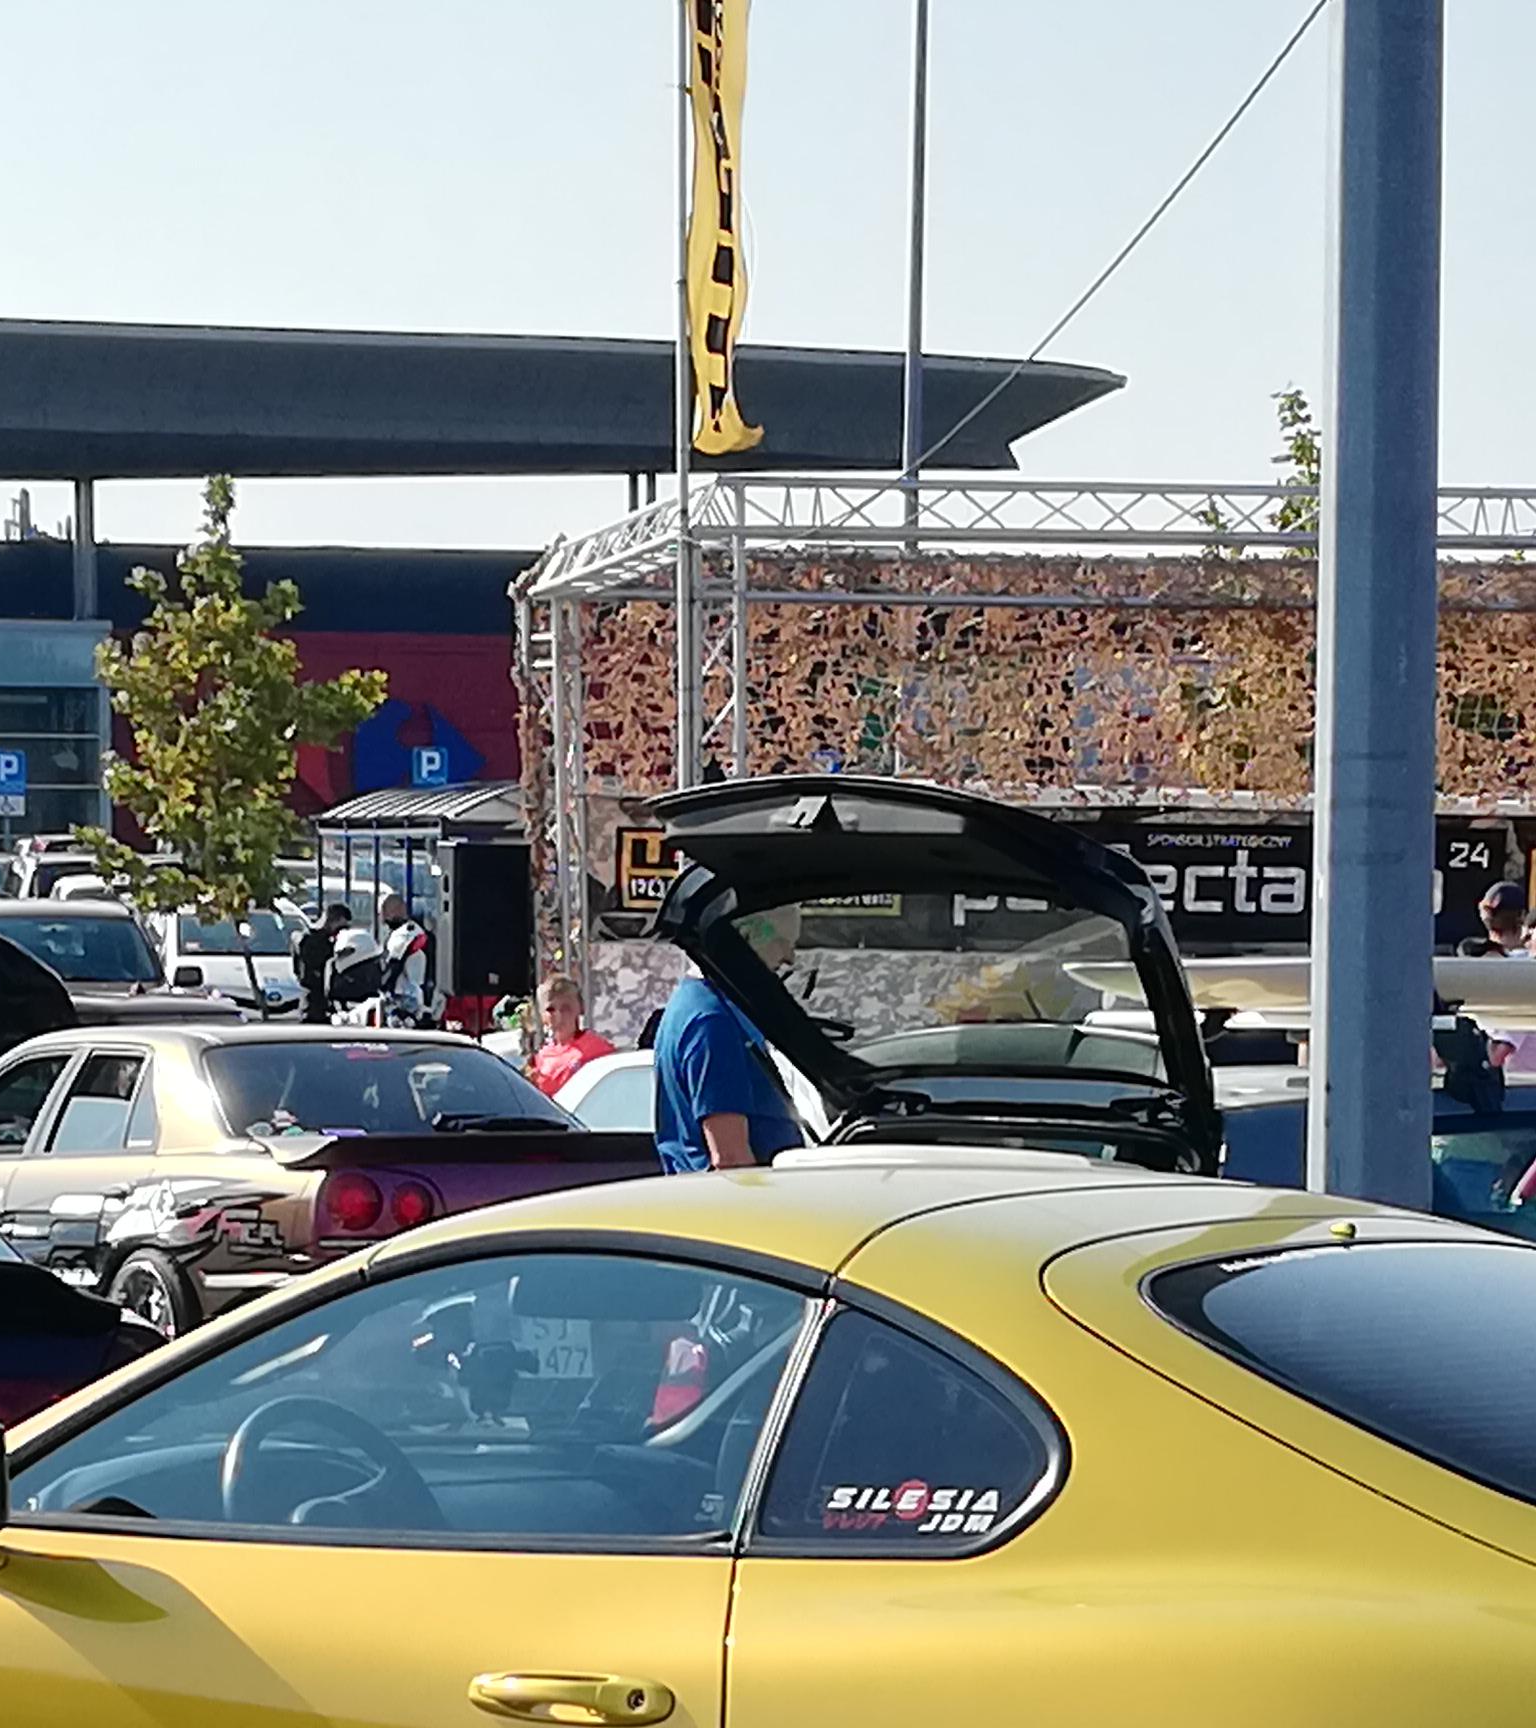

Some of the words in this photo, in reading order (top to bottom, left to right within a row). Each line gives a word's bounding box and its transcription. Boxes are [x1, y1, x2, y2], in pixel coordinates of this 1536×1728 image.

[0, 753, 19, 782] P
[421, 751, 441, 778] P
[1449, 842, 1490, 869] 24
[827, 1487, 999, 1512] SILESIA
[918, 1513, 995, 1534] JDM
